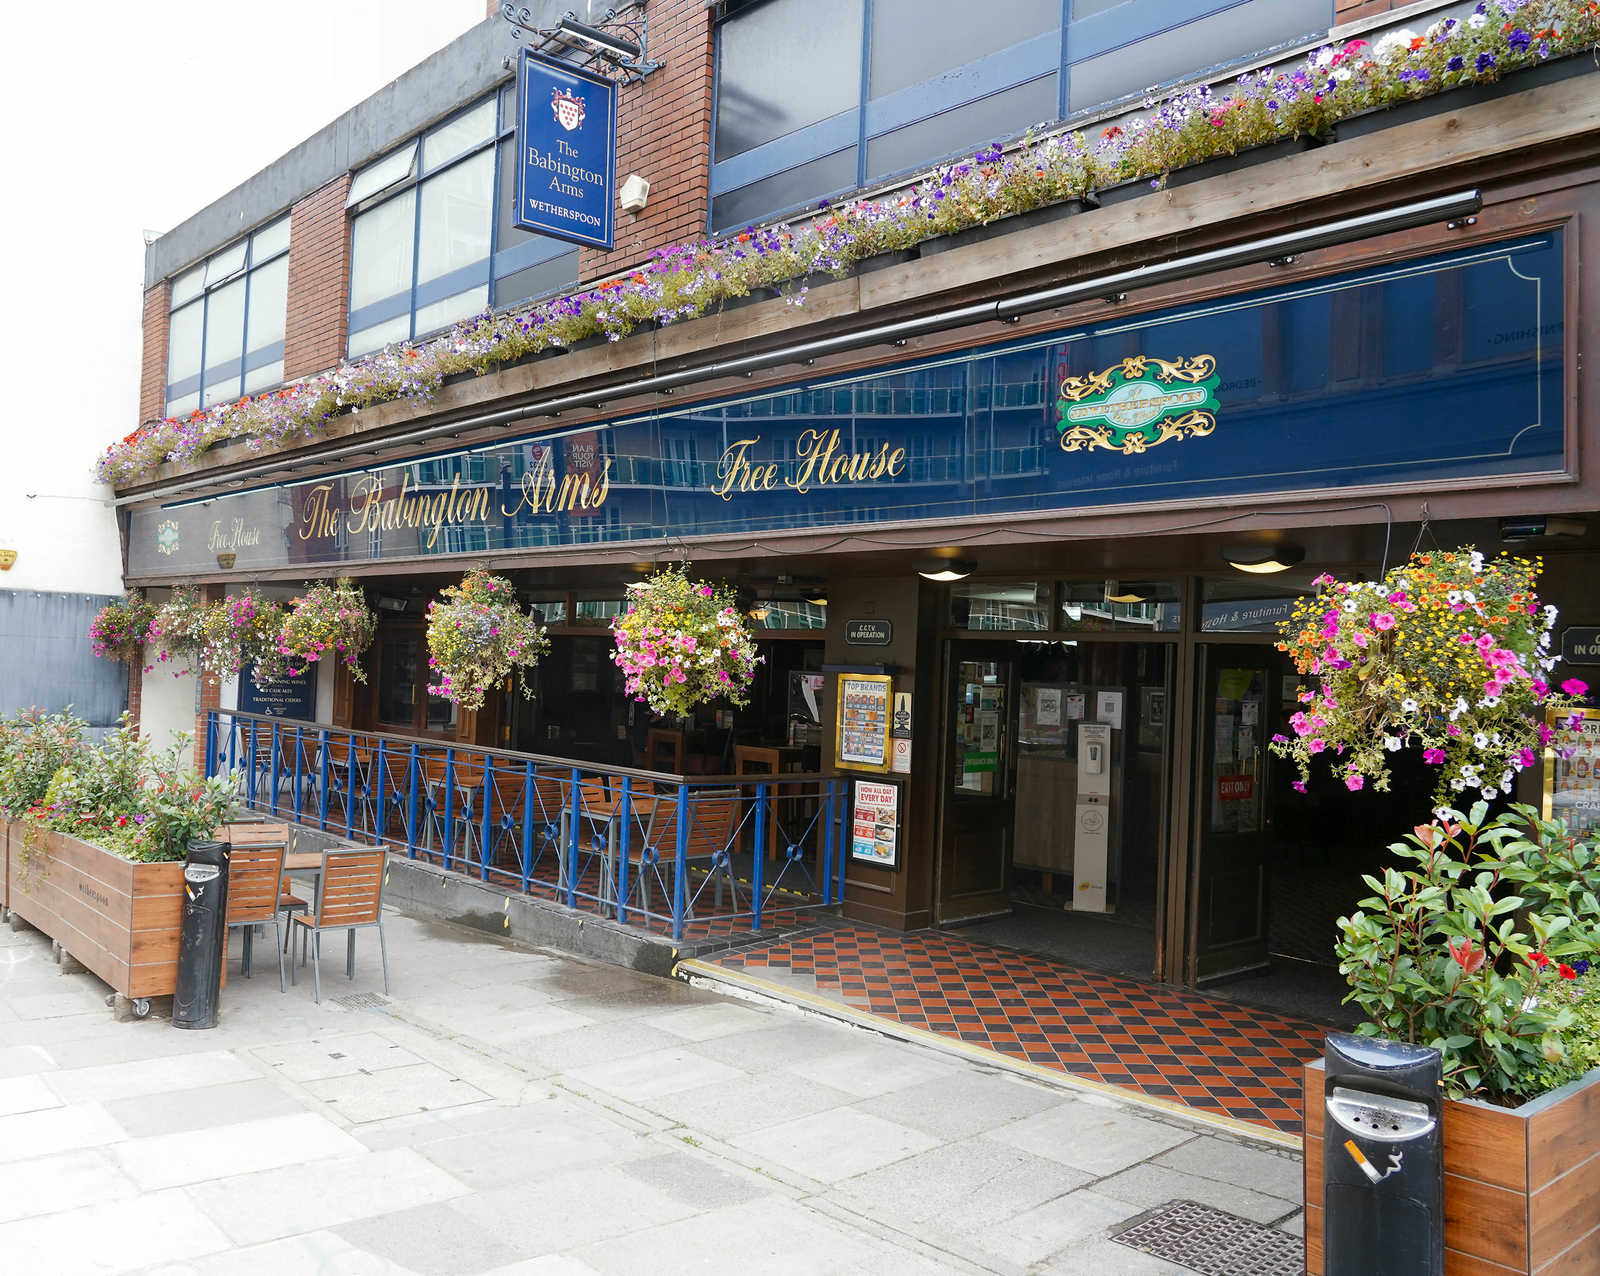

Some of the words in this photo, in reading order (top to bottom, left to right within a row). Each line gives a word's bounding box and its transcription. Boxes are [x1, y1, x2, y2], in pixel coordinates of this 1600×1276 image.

[557, 140, 579, 158] The
[528, 146, 604, 187] Babington
[549, 176, 584, 199] Arms
[529, 198, 601, 227] WETHERSPOON
[711, 435, 779, 501] Free
[785, 428, 906, 494] House
[299, 483, 340, 540] The
[347, 472, 491, 549] Babington
[501, 446, 612, 517] Arms
[207, 518, 228, 553] Free
[228, 516, 260, 551] House
[857, 631, 885, 639] OPERATION
[1573, 644, 1587, 655] IN
[847, 682, 860, 690] TOP
[860, 683, 887, 692] BRANDS
[1221, 780, 1235, 794] EXIT
[1234, 779, 1251, 793] ONLY
[860, 793, 880, 802] EVERY
[880, 795, 893, 804] DAY
